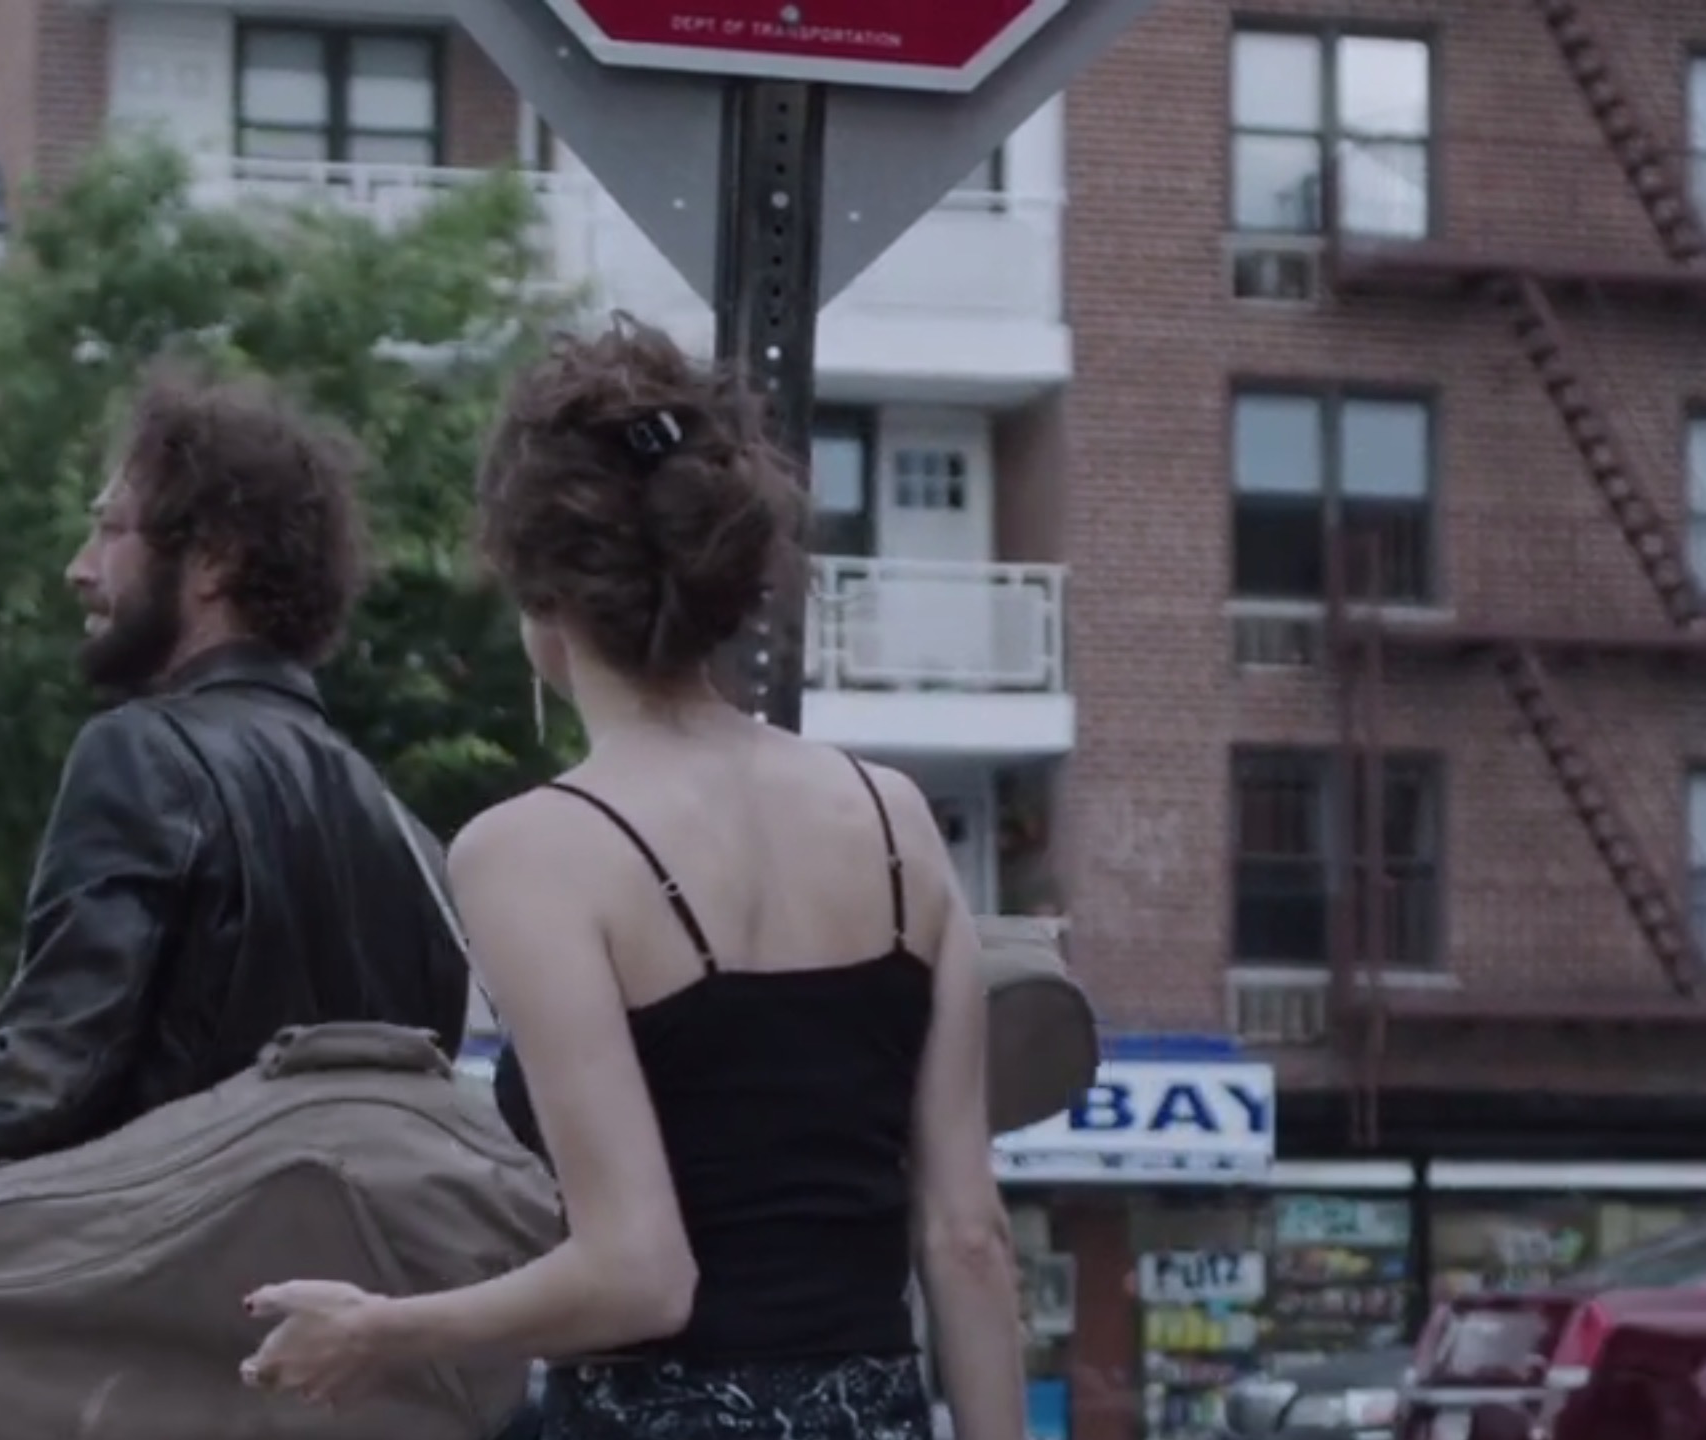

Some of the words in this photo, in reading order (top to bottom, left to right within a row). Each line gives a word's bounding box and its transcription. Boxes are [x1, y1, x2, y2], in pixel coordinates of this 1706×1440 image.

[722, 19, 744, 34] OF
[751, 20, 902, 47] TRANSPORTATION
[1069, 1083, 1270, 1133] BAY
